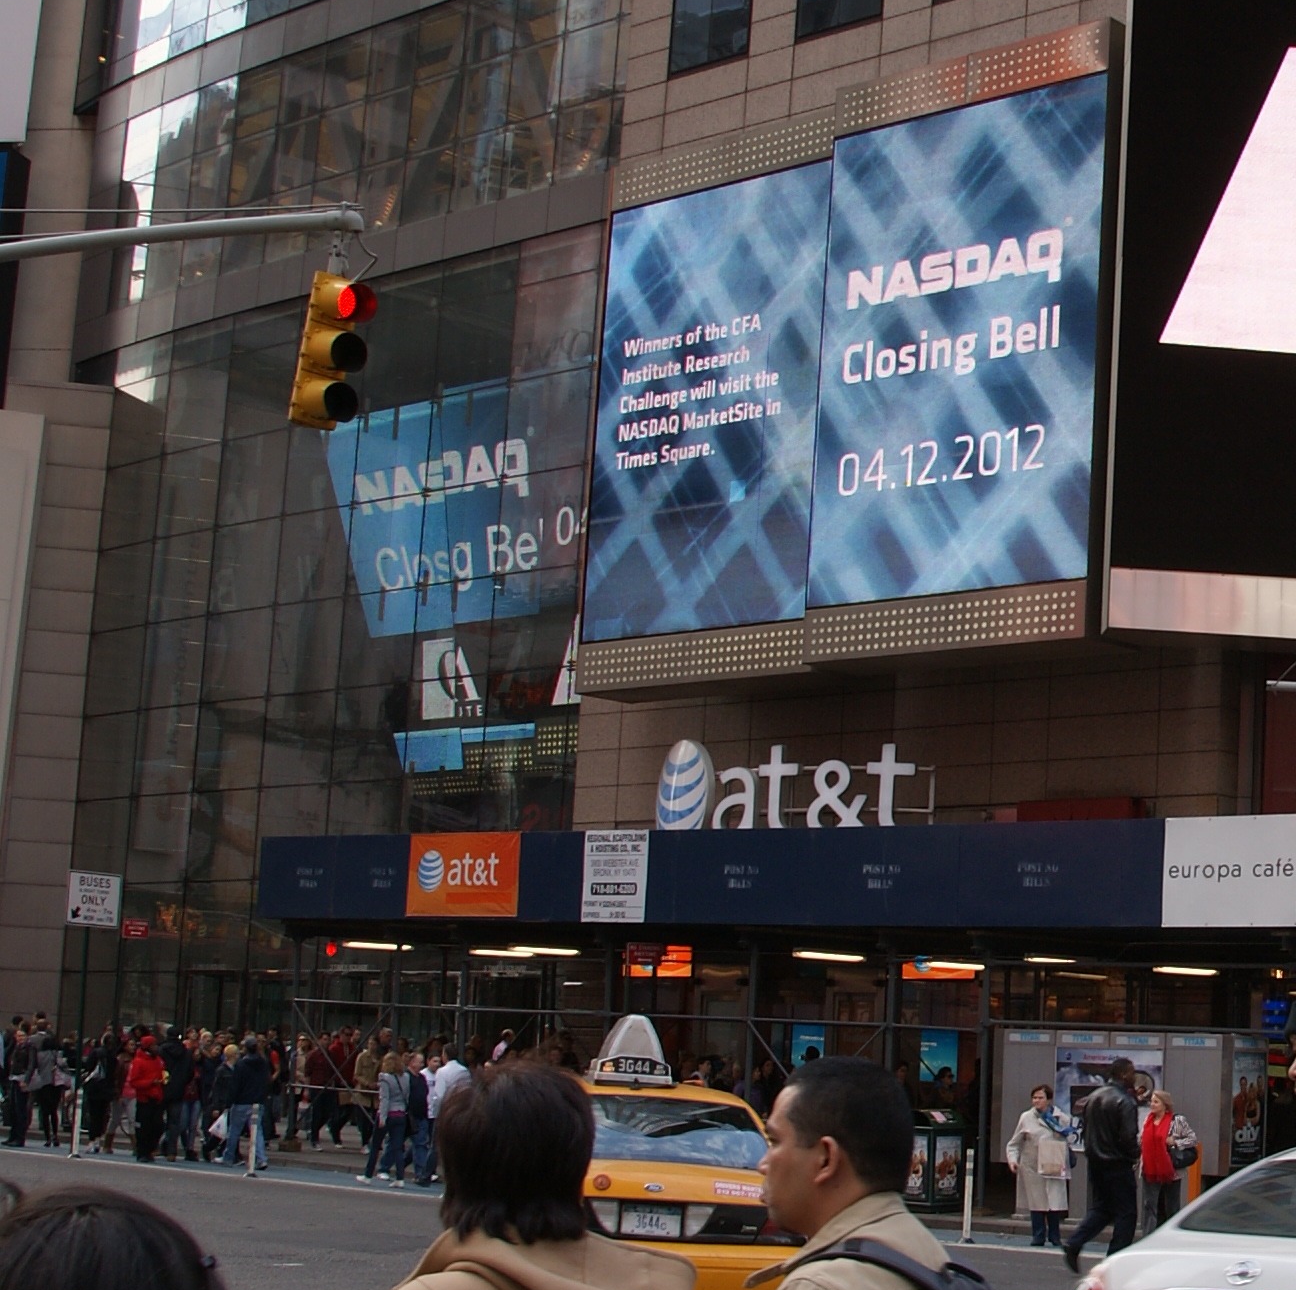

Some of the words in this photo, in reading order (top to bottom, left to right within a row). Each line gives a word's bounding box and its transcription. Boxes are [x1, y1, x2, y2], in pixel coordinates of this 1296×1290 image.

[846, 228, 1064, 311] NASDAQ
[623, 333, 683, 359] Winners
[685, 326, 703, 347] of
[704, 321, 729, 343] the
[731, 313, 763, 338] CFA
[988, 305, 1062, 360] Bell
[621, 359, 682, 386] Institute
[684, 345, 751, 376] Research
[841, 328, 978, 387] Closing
[619, 386, 688, 416] Challenge
[690, 380, 717, 403] will
[718, 375, 748, 397] visit
[749, 369, 780, 391] the
[618, 413, 681, 444] NASDAQ
[682, 400, 764, 432] MarketSite
[765, 397, 782, 418] in
[615, 448, 659, 472] Times
[660, 439, 717, 469] Square.
[837, 423, 1046, 498] 04.12.2012
[712, 742, 916, 829] at&t
[79, 875, 111, 889] BUSES
[447, 852, 499, 887] at&t
[1168, 861, 1243, 884] europa
[1252, 857, 1295, 880] café
[81, 894, 107, 906] ONLY
[618, 1058, 650, 1073] 3G44
